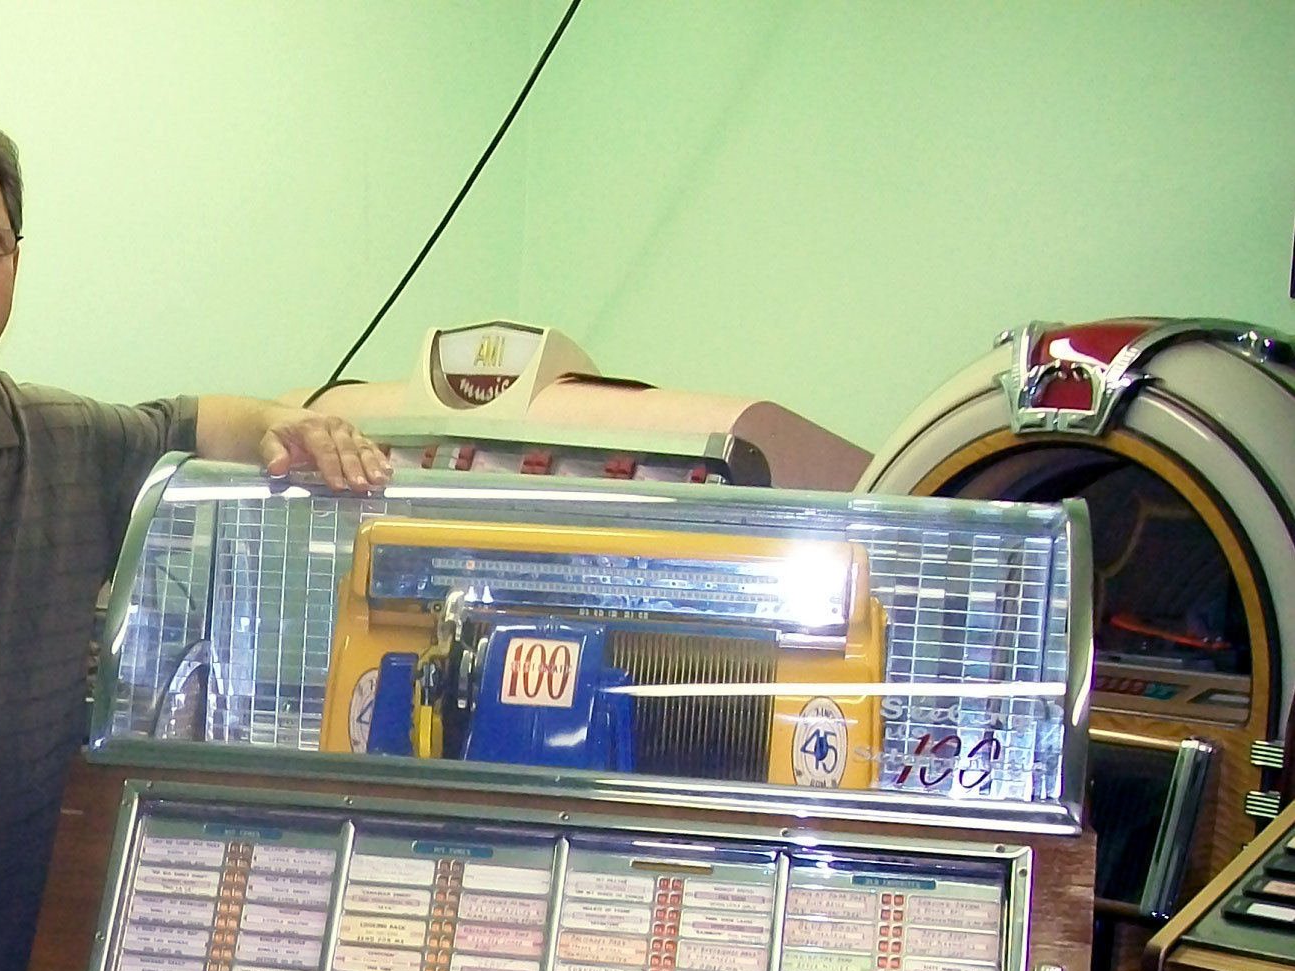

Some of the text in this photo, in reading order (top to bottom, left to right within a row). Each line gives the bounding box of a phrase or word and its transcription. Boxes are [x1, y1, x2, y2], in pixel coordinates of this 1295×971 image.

[459, 376, 510, 401] music
[507, 643, 571, 700] 100
[800, 728, 838, 774] 45
